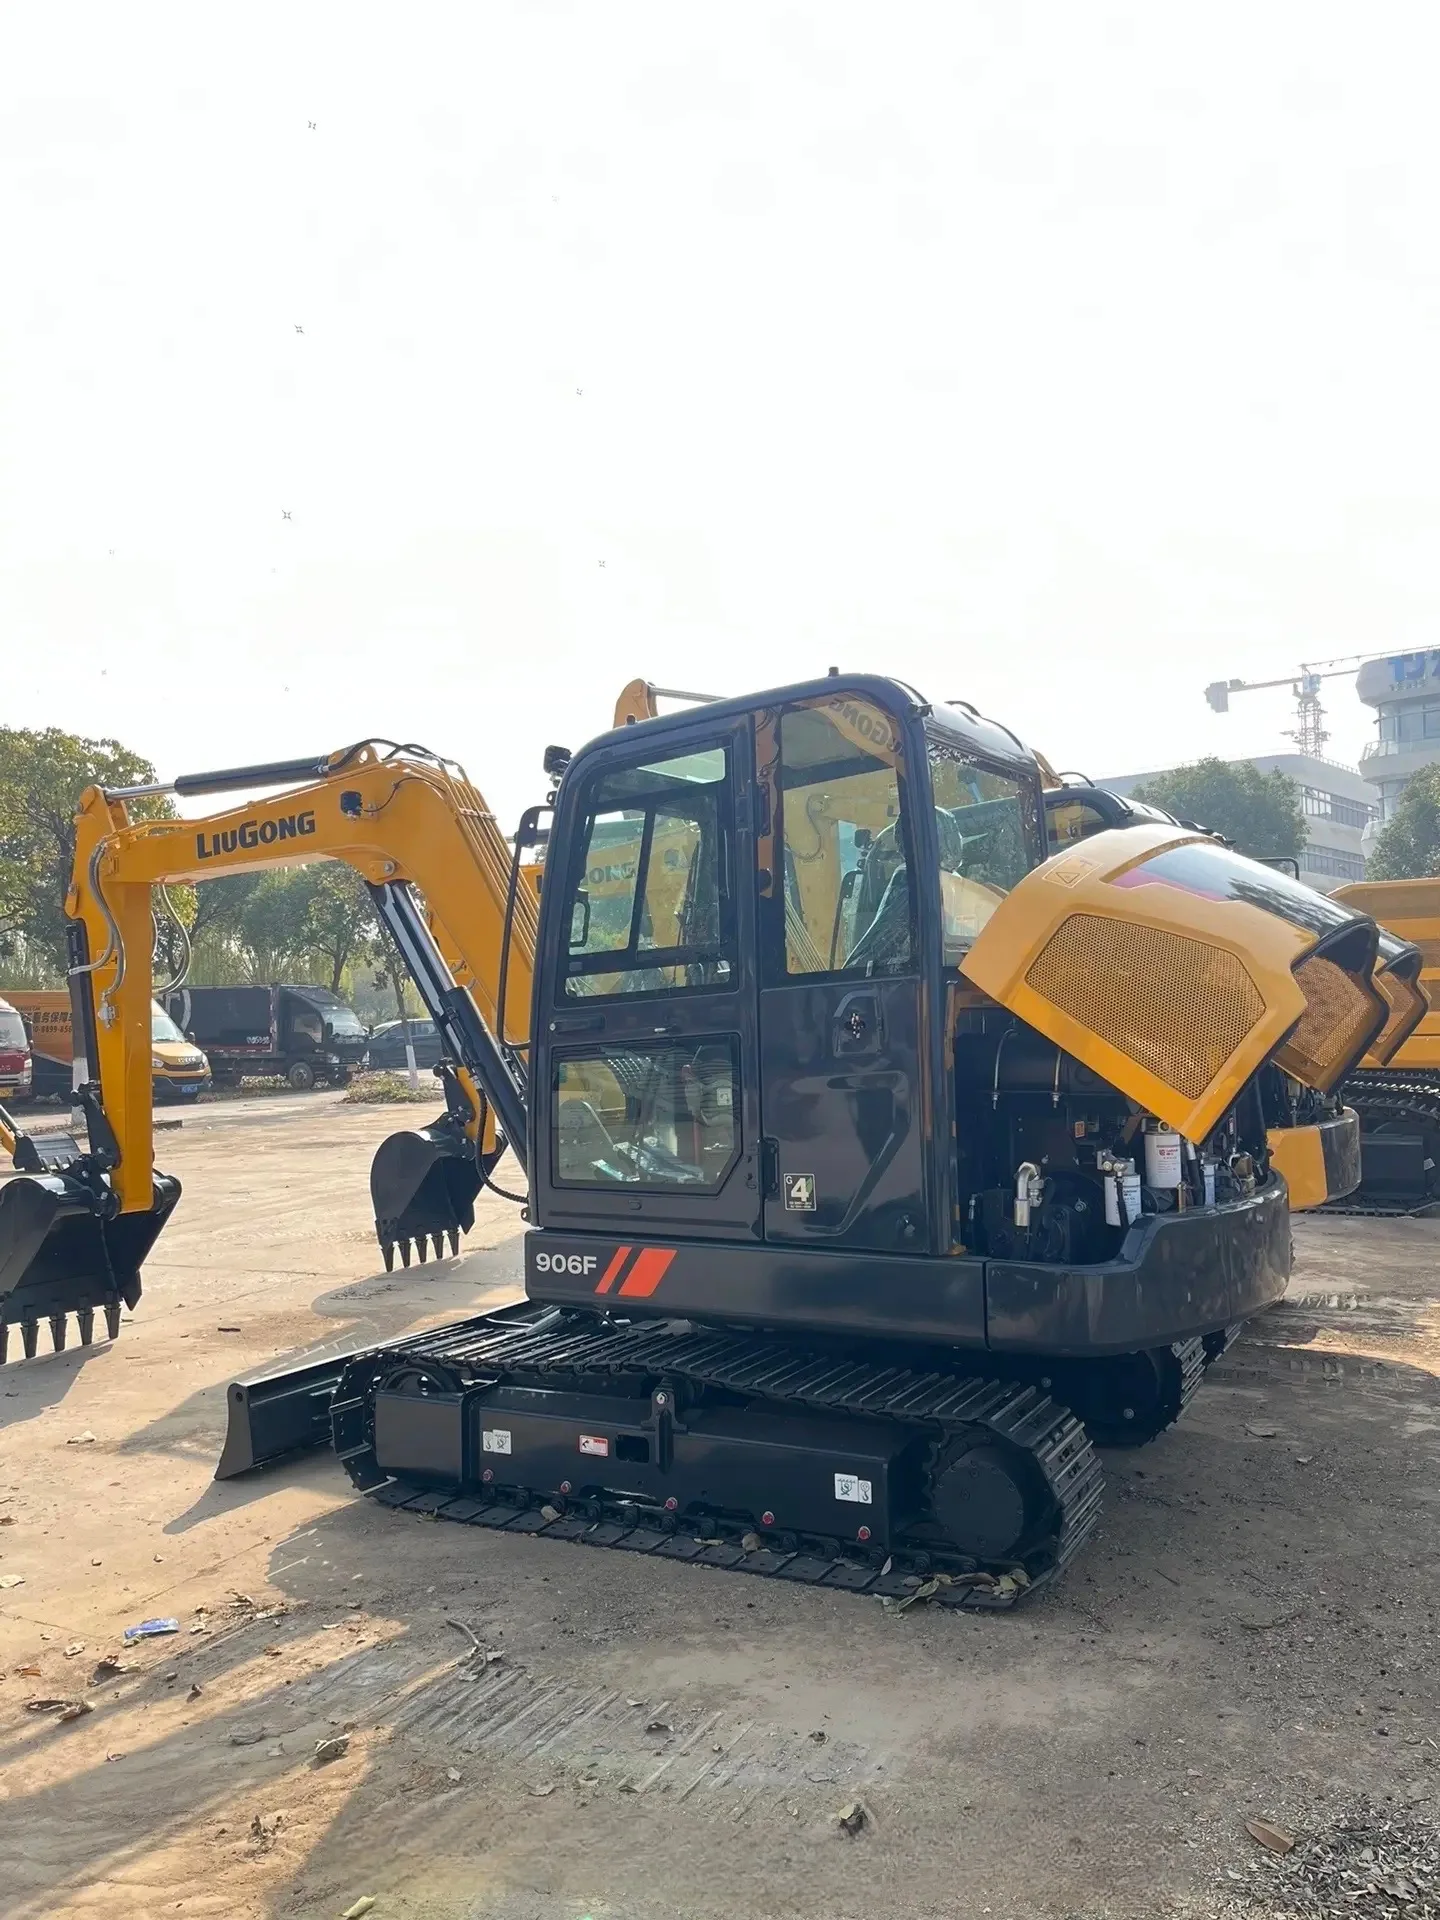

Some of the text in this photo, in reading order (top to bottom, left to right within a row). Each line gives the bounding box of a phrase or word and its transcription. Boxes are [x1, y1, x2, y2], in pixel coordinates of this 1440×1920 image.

[196, 810, 316, 859] LIUGONG
[22, 1011, 72, 1023] 服务保障
[785, 1175, 810, 1202] G 4
[536, 1252, 597, 1275] 906F
